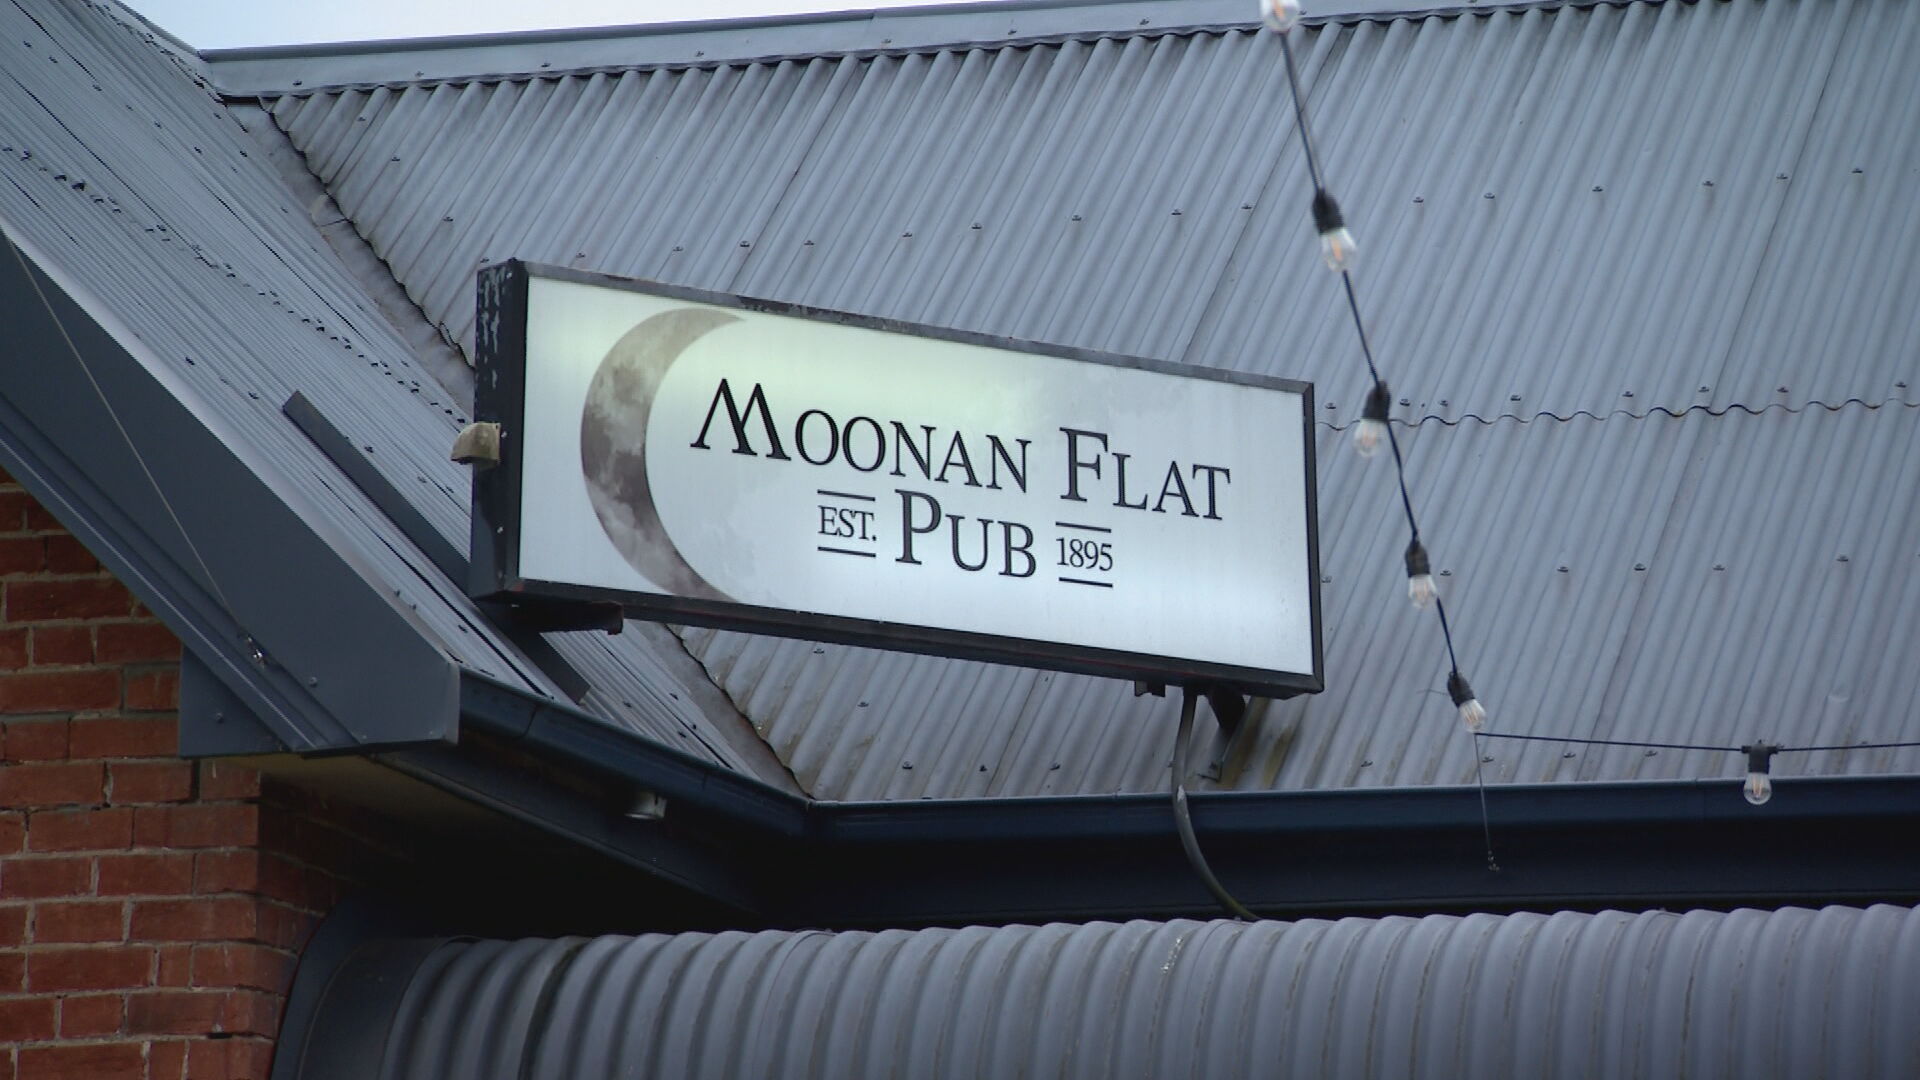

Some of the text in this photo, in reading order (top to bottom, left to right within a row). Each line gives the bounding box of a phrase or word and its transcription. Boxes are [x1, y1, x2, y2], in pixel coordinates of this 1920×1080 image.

[690, 378, 1231, 521] MOONAN FLAT
[818, 488, 1113, 579] EST. PUB 1895
